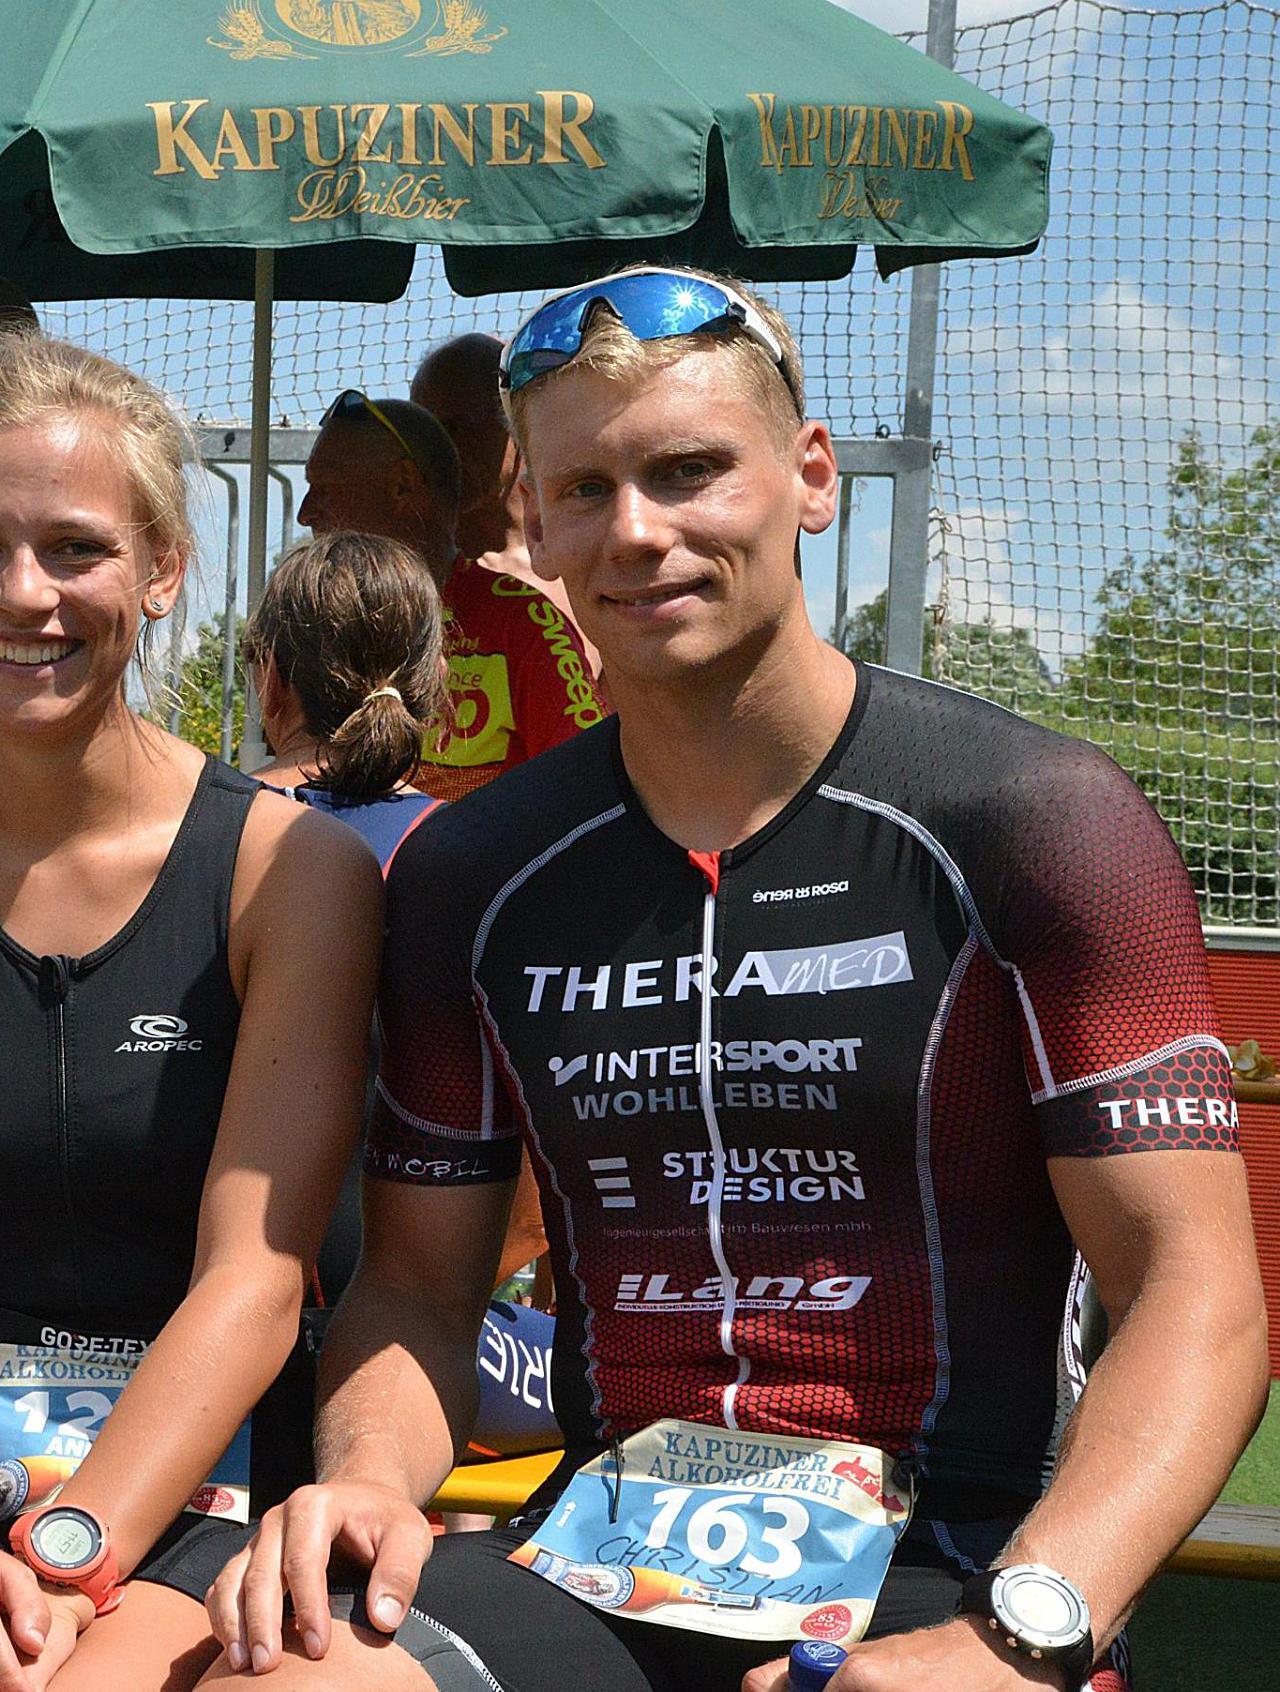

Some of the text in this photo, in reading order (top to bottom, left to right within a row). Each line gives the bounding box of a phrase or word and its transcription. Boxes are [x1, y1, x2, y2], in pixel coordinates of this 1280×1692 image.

[147, 89, 608, 180] KAPUZINER
[747, 92, 976, 182] KAPUZINER
[113, 1040, 203, 1053] AROPEC
[594, 1037, 863, 1083] INTERSPORT
[689, 1175, 866, 1206] DESIGN
[751, 1221, 831, 1235] Bauwesen
[14, 1390, 114, 1442] 12
[664, 1431, 829, 1474] KAPUZINER
[647, 1455, 846, 1502] ALKOHOLFREI
[643, 1487, 811, 1580] 163
[595, 1536, 844, 1605] CHRISTIAN
